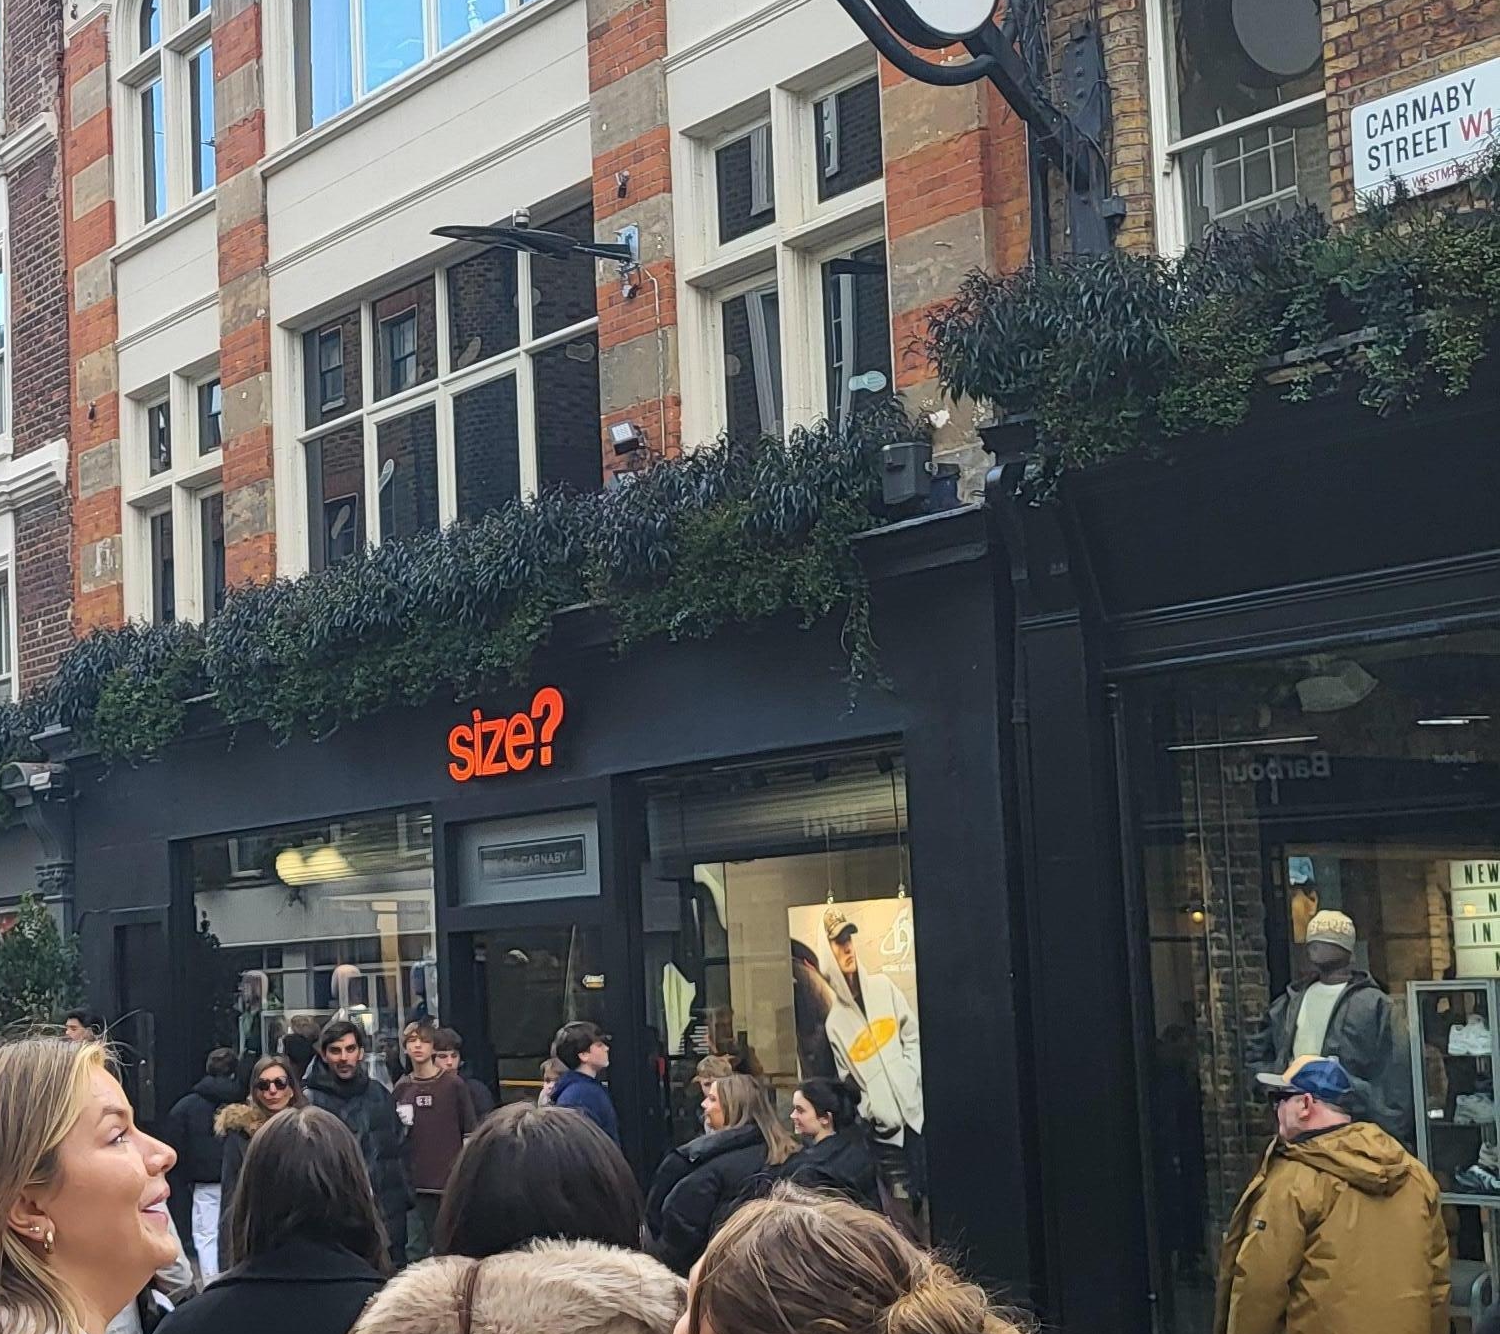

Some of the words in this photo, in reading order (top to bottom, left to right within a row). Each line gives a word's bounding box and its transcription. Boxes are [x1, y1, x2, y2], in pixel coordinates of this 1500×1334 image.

[1366, 78, 1476, 140] CARNABY
[1368, 121, 1451, 172] STREET
[1459, 107, 1494, 142] W1
[448, 687, 564, 782] size?
[1464, 863, 1499, 884] NEW
[1472, 922, 1492, 943] IN
